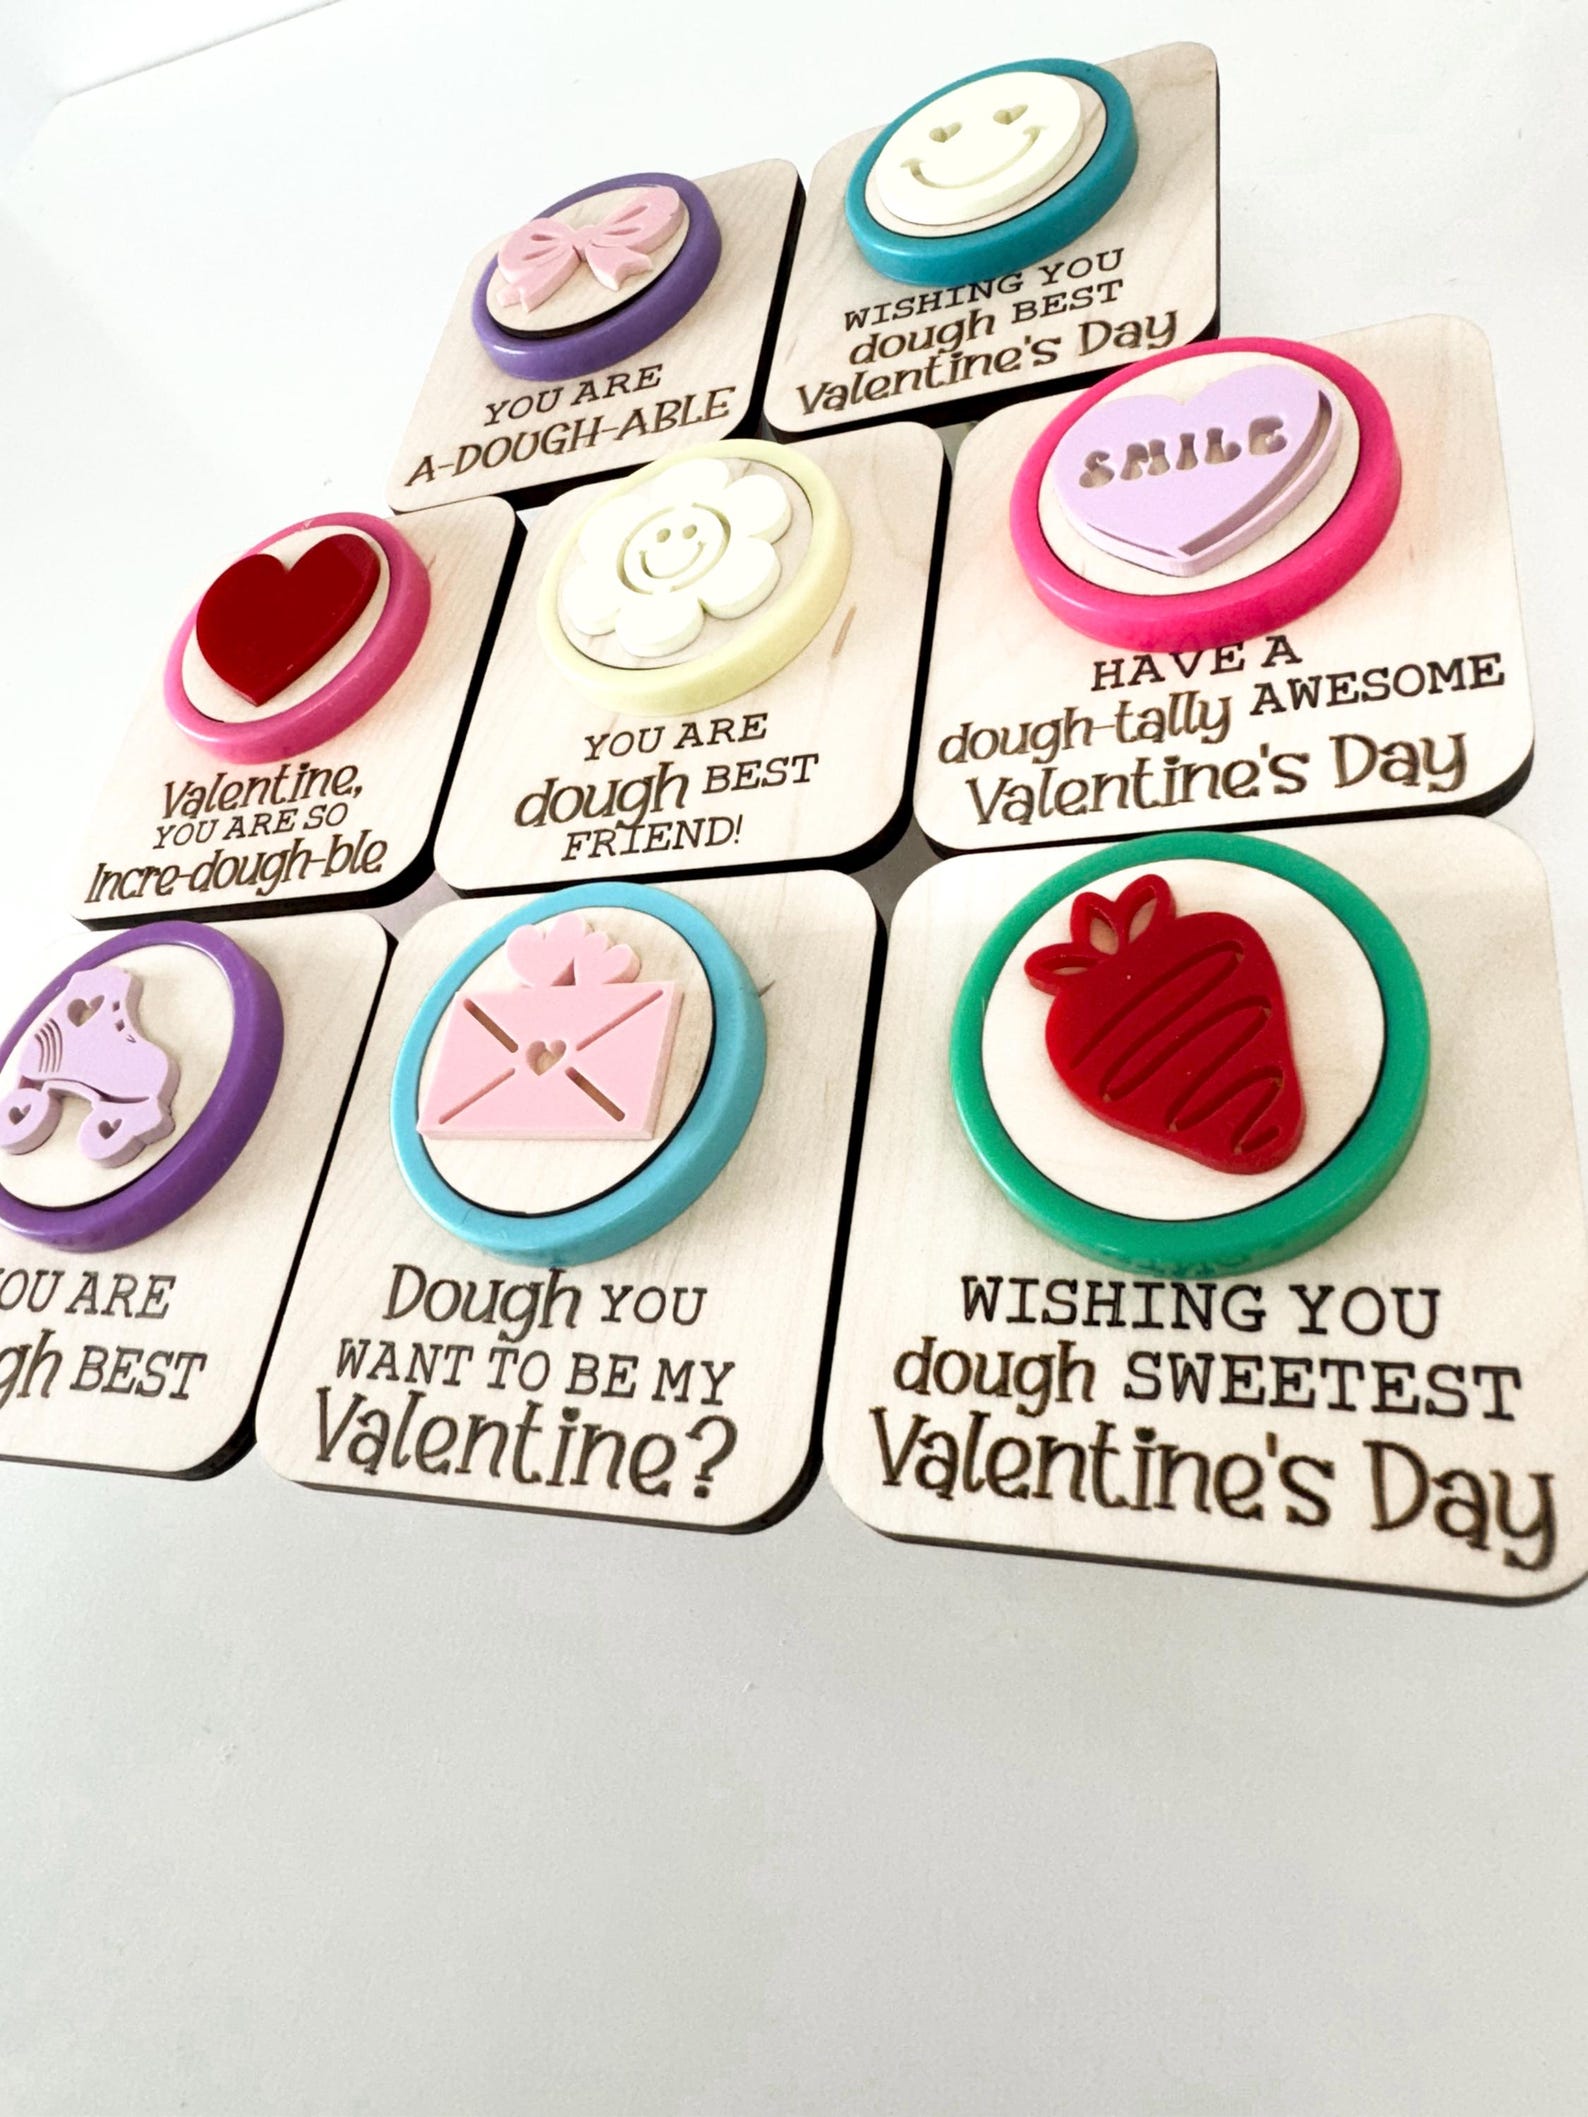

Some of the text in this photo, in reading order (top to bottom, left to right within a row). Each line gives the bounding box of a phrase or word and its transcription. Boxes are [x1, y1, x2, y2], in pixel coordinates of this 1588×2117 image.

[844, 247, 1125, 331] WISHING YOU
[849, 278, 1124, 366] dough BEST
[483, 363, 663, 427] YOU ARE
[796, 310, 1178, 415] Valentine's Day
[404, 386, 736, 486] A-DOUGH-ABLE
[1079, 415, 1288, 488] SMILE
[1091, 634, 1303, 691] HAVE A
[583, 712, 768, 762] YOU ARE
[938, 653, 1505, 765] dough-tally AWESOME
[163, 762, 363, 820] Valentine,
[514, 753, 820, 830] dough BEST
[966, 732, 1467, 826] Valentine's Day
[154, 803, 349, 851] YOU ARE SO
[560, 814, 744, 862] FRIEND!
[83, 832, 389, 904] Incre-dough-ble
[0, 1268, 176, 1319] OU ARE
[382, 1264, 707, 1343] Dough YOU
[961, 1275, 1441, 1339] WISHING YOU
[69, 1344, 208, 1400] BEST
[336, 1338, 737, 1406] WANT TO BE MY
[893, 1336, 1522, 1421] dough SWEETEST
[315, 1386, 738, 1499] Valentine?
[870, 1406, 1556, 1571] Valentine's Day
